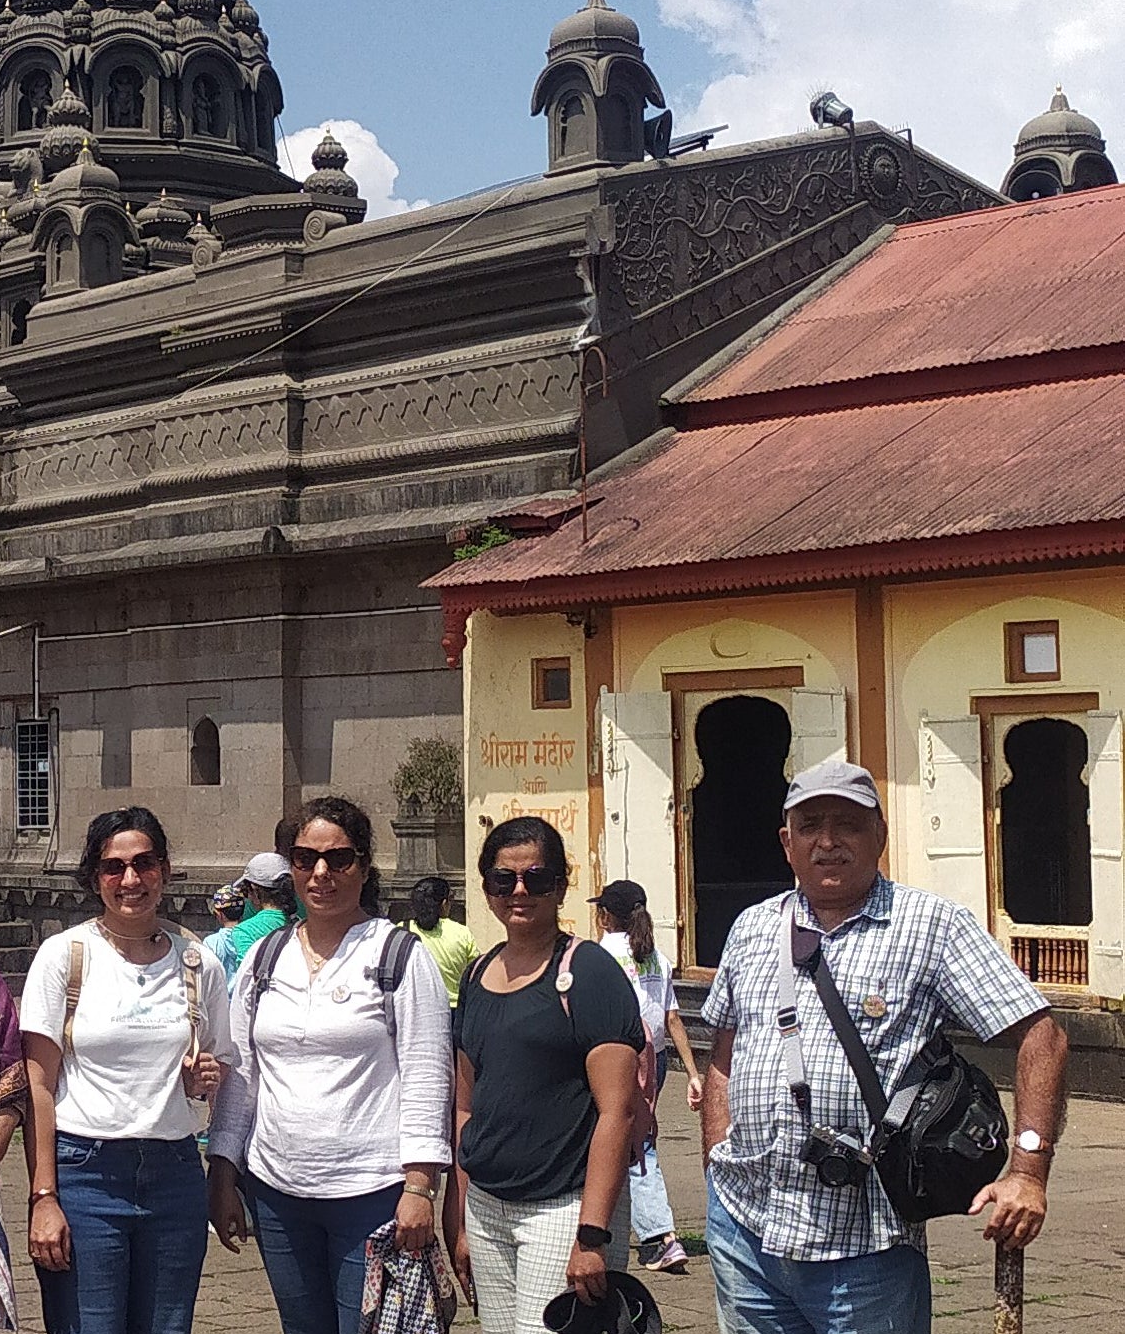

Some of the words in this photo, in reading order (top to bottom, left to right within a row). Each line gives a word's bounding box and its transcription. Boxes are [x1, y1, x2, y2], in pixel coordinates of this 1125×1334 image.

[480, 732, 528, 768] श्रीराम
[532, 732, 576, 775] मंदीर
[521, 775, 548, 795] आणि
